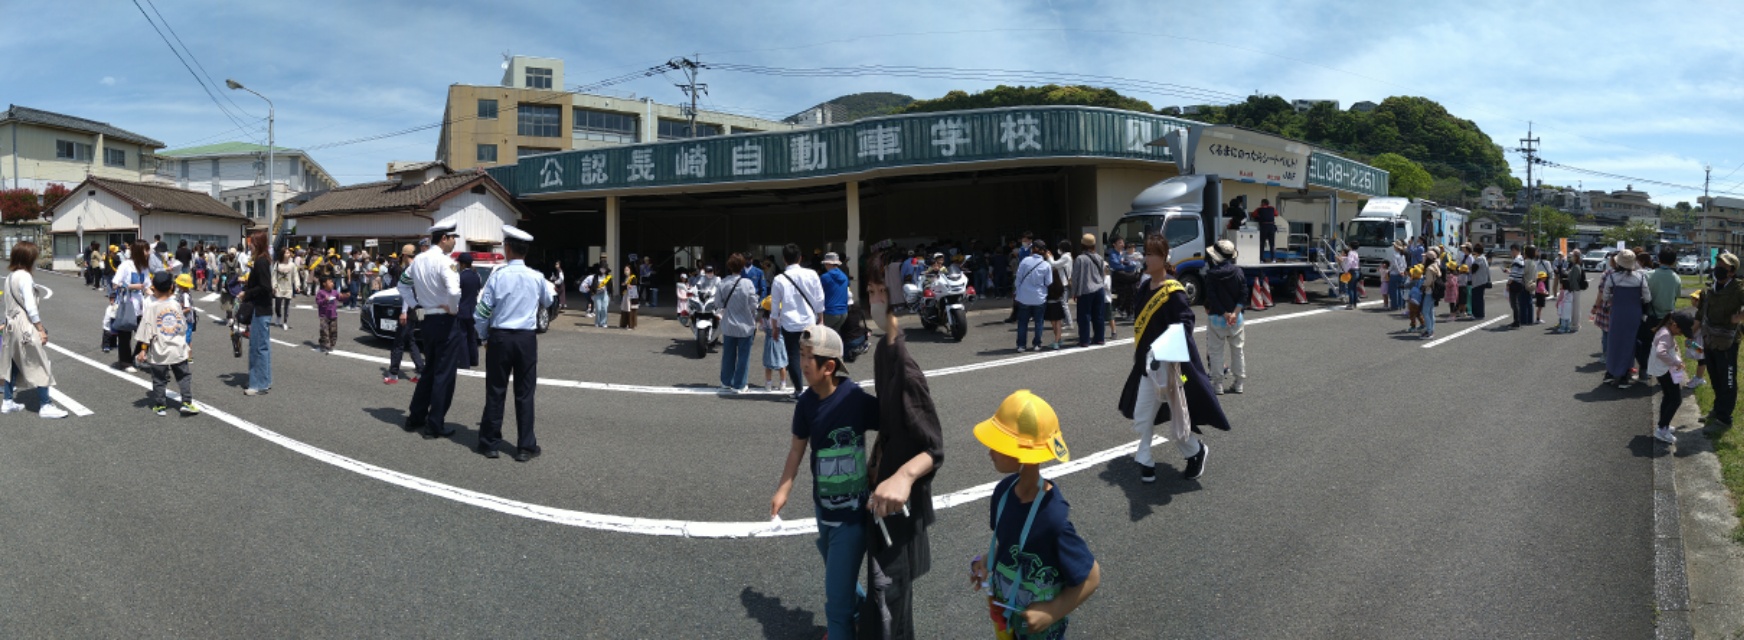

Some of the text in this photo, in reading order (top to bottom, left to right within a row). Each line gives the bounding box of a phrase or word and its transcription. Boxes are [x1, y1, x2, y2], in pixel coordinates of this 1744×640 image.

[539, 113, 1042, 188] 公認長崎自動車学校
